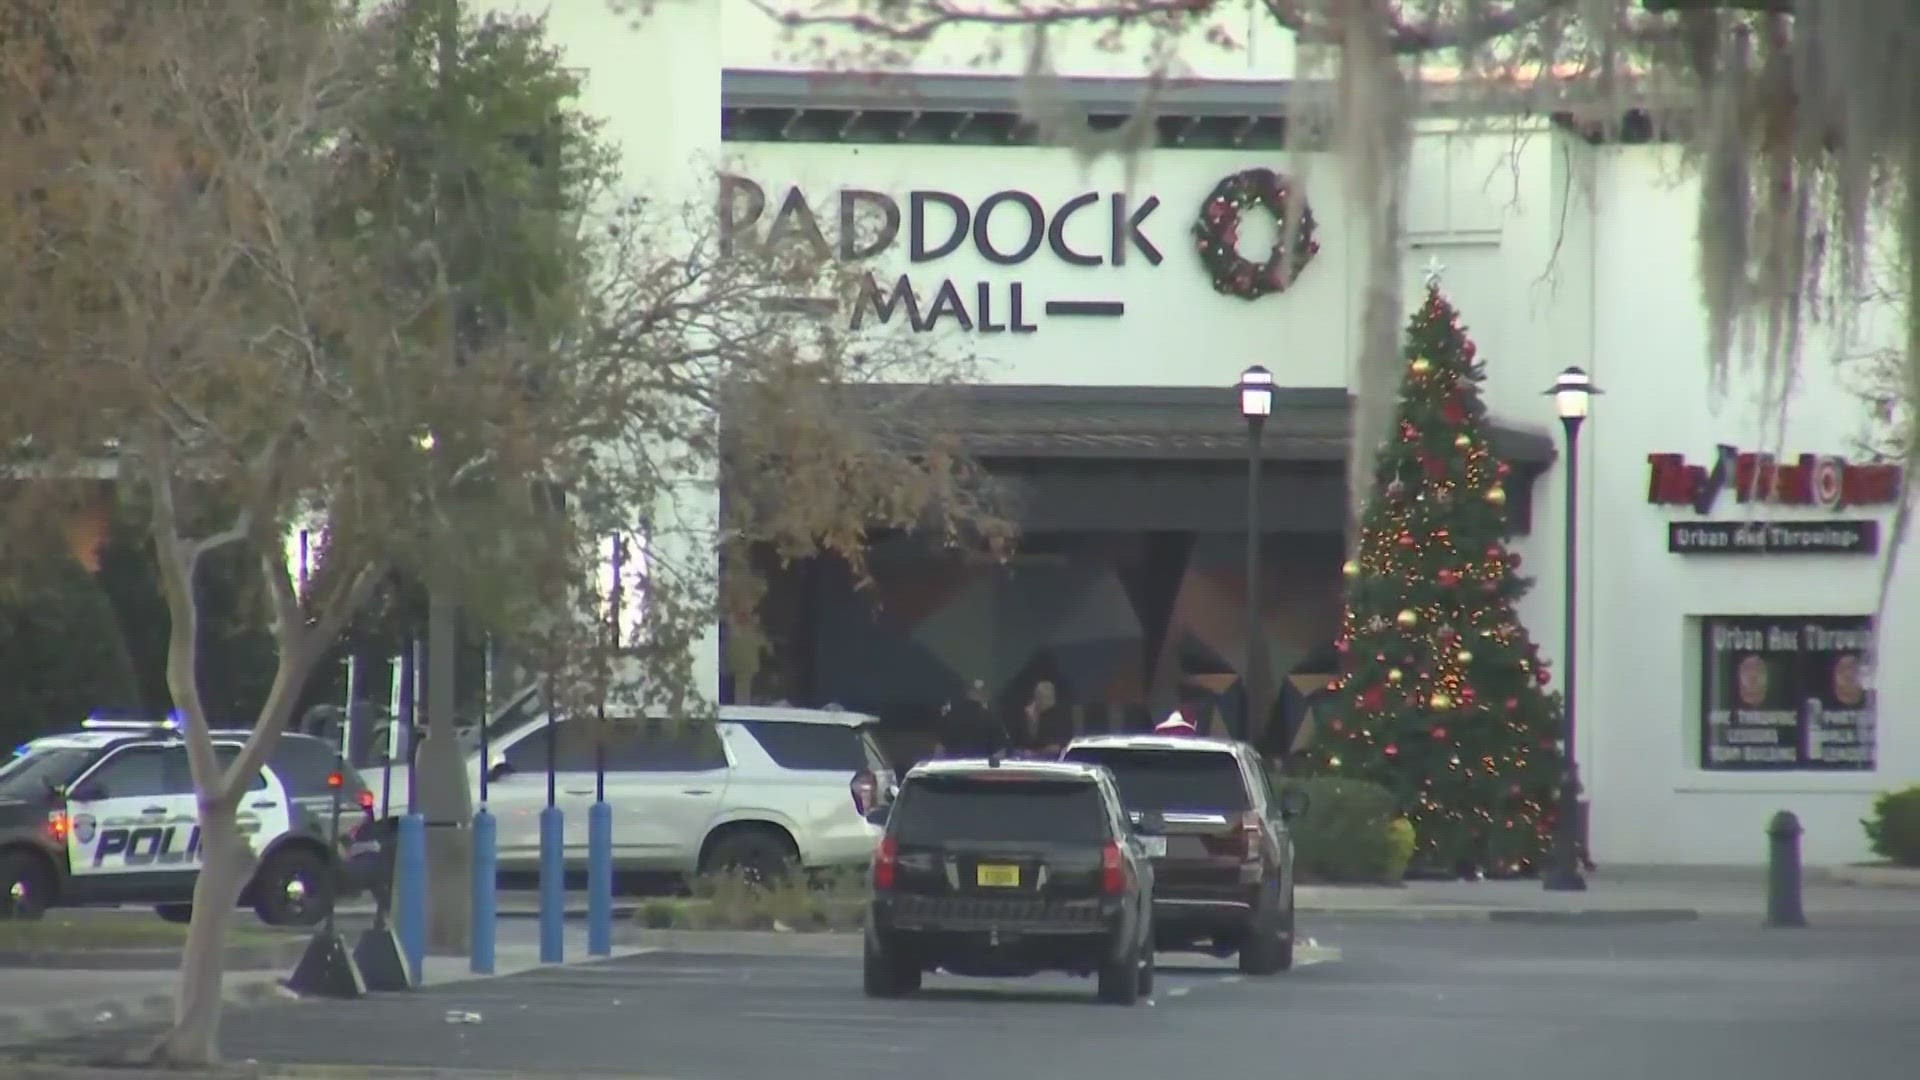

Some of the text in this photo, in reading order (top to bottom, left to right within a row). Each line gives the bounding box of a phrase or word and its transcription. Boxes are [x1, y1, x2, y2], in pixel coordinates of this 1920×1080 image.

[719, 174, 1163, 266] PADDOCK
[850, 271, 1037, 332] MALL
[1678, 527, 1728, 547] Urban
[93, 825, 202, 868] POLI
